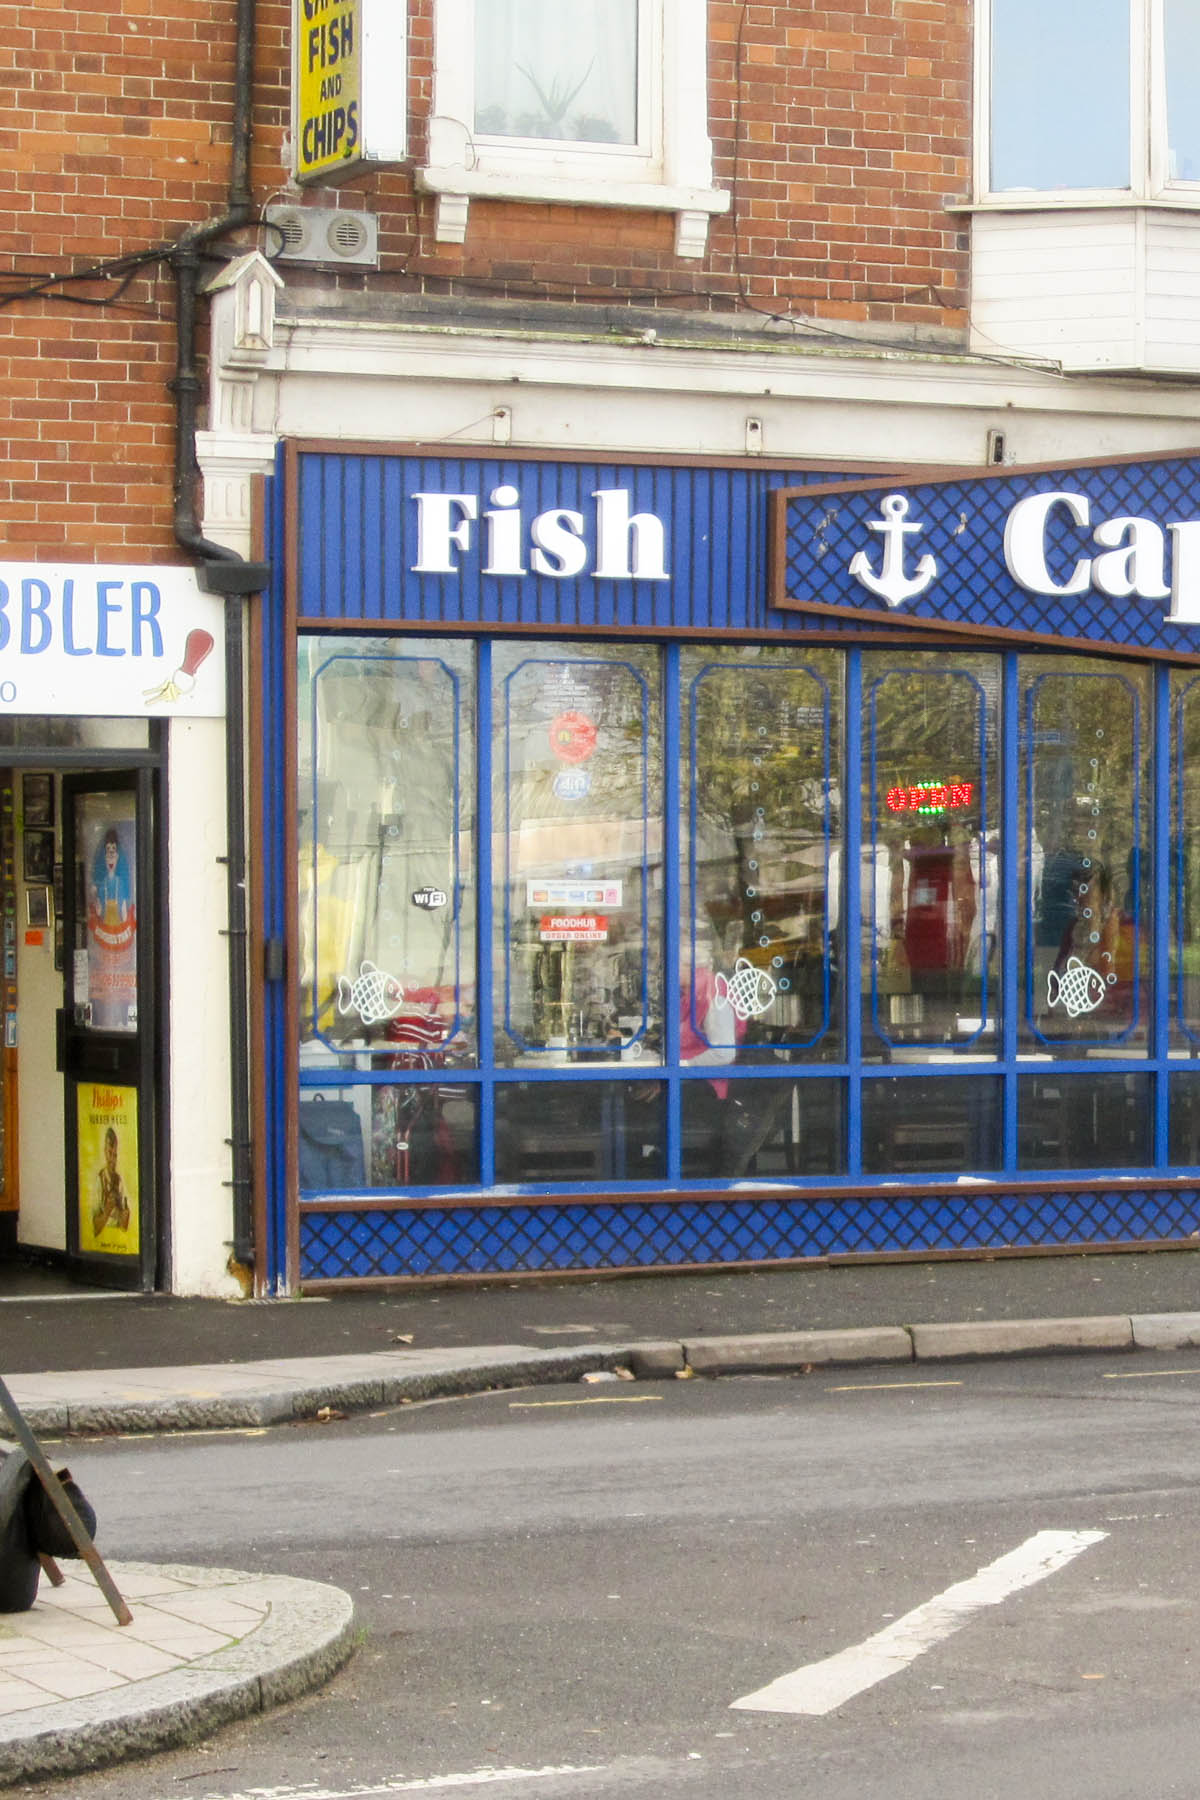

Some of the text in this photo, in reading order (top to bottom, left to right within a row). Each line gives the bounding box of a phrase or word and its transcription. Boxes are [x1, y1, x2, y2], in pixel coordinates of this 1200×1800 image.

[309, 12, 353, 73] FISH
[320, 73, 341, 102] AND
[302, 100, 357, 164] CHIPS
[410, 485, 670, 580] Fish
[887, 784, 974, 811] OPEN
[551, 918, 596, 929] FOODHUB
